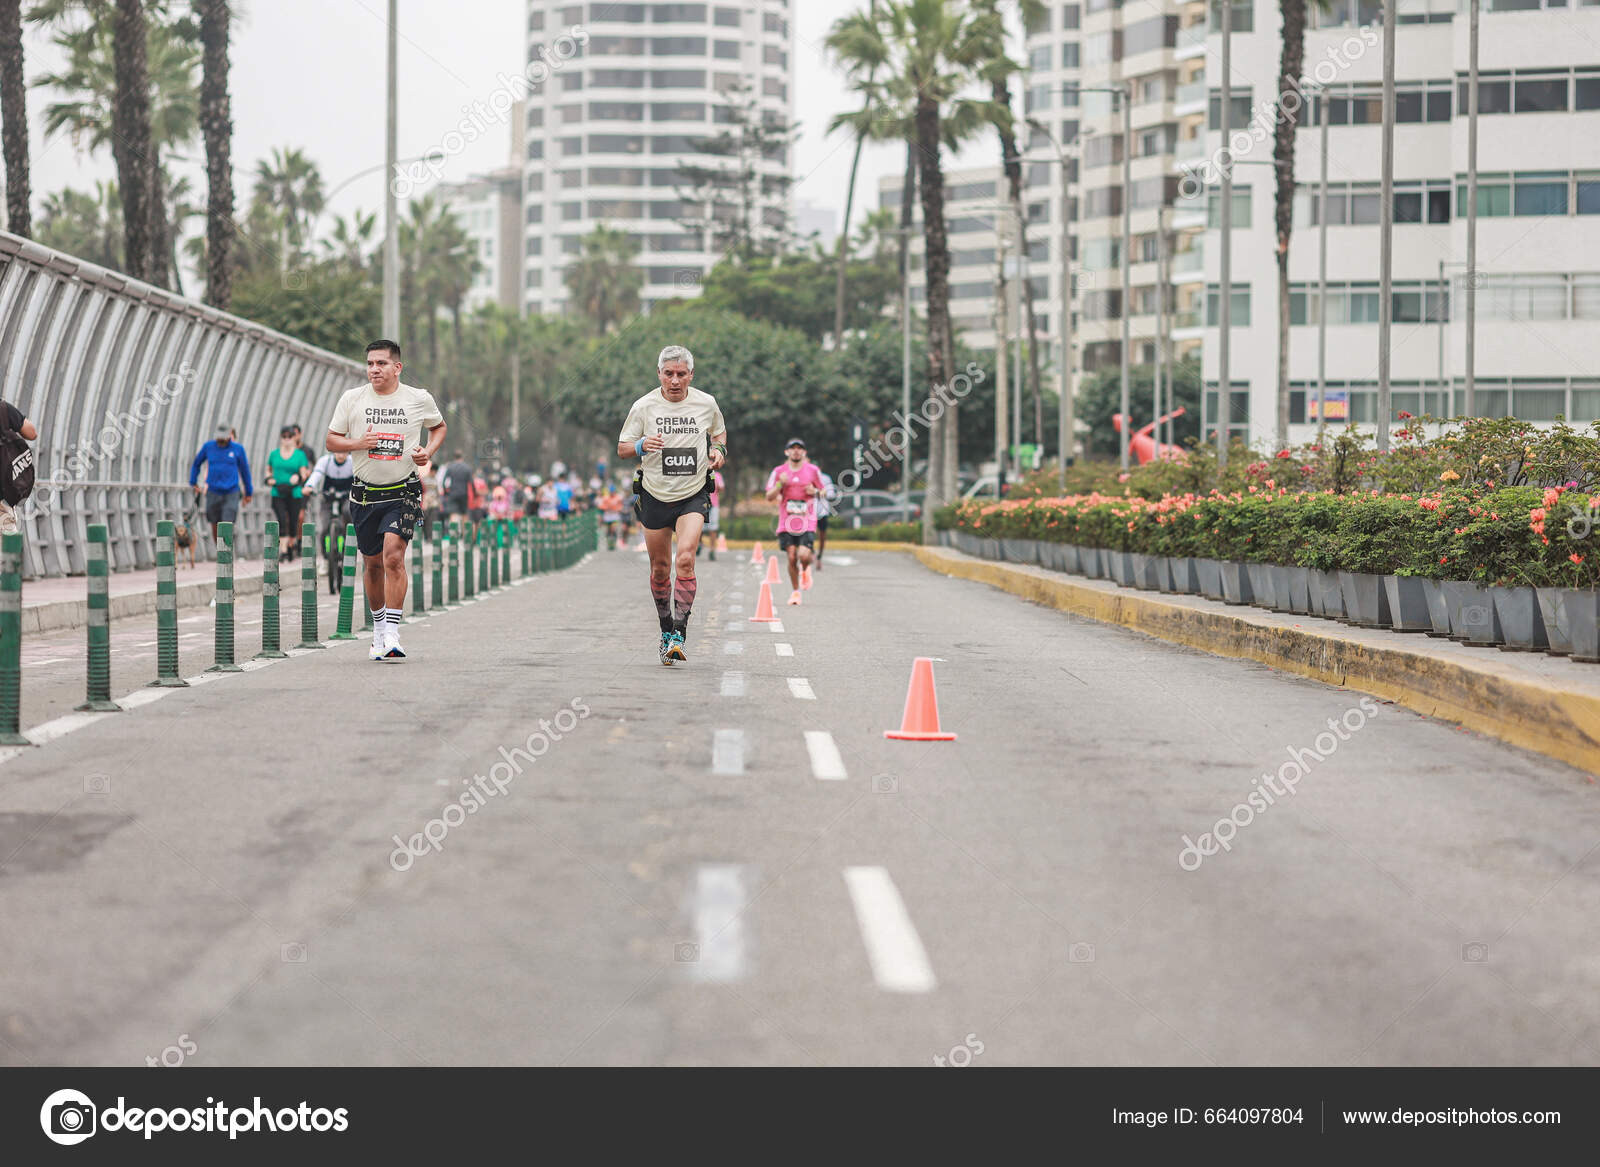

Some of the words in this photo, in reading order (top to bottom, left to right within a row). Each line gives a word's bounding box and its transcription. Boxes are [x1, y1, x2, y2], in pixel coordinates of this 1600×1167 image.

[365, 407, 405, 416] CREMA
[366, 416, 408, 425] RUNNERS
[655, 417, 697, 426] CREMA
[657, 426, 700, 434] RUNNERS
[664, 455, 695, 466] GUIA
